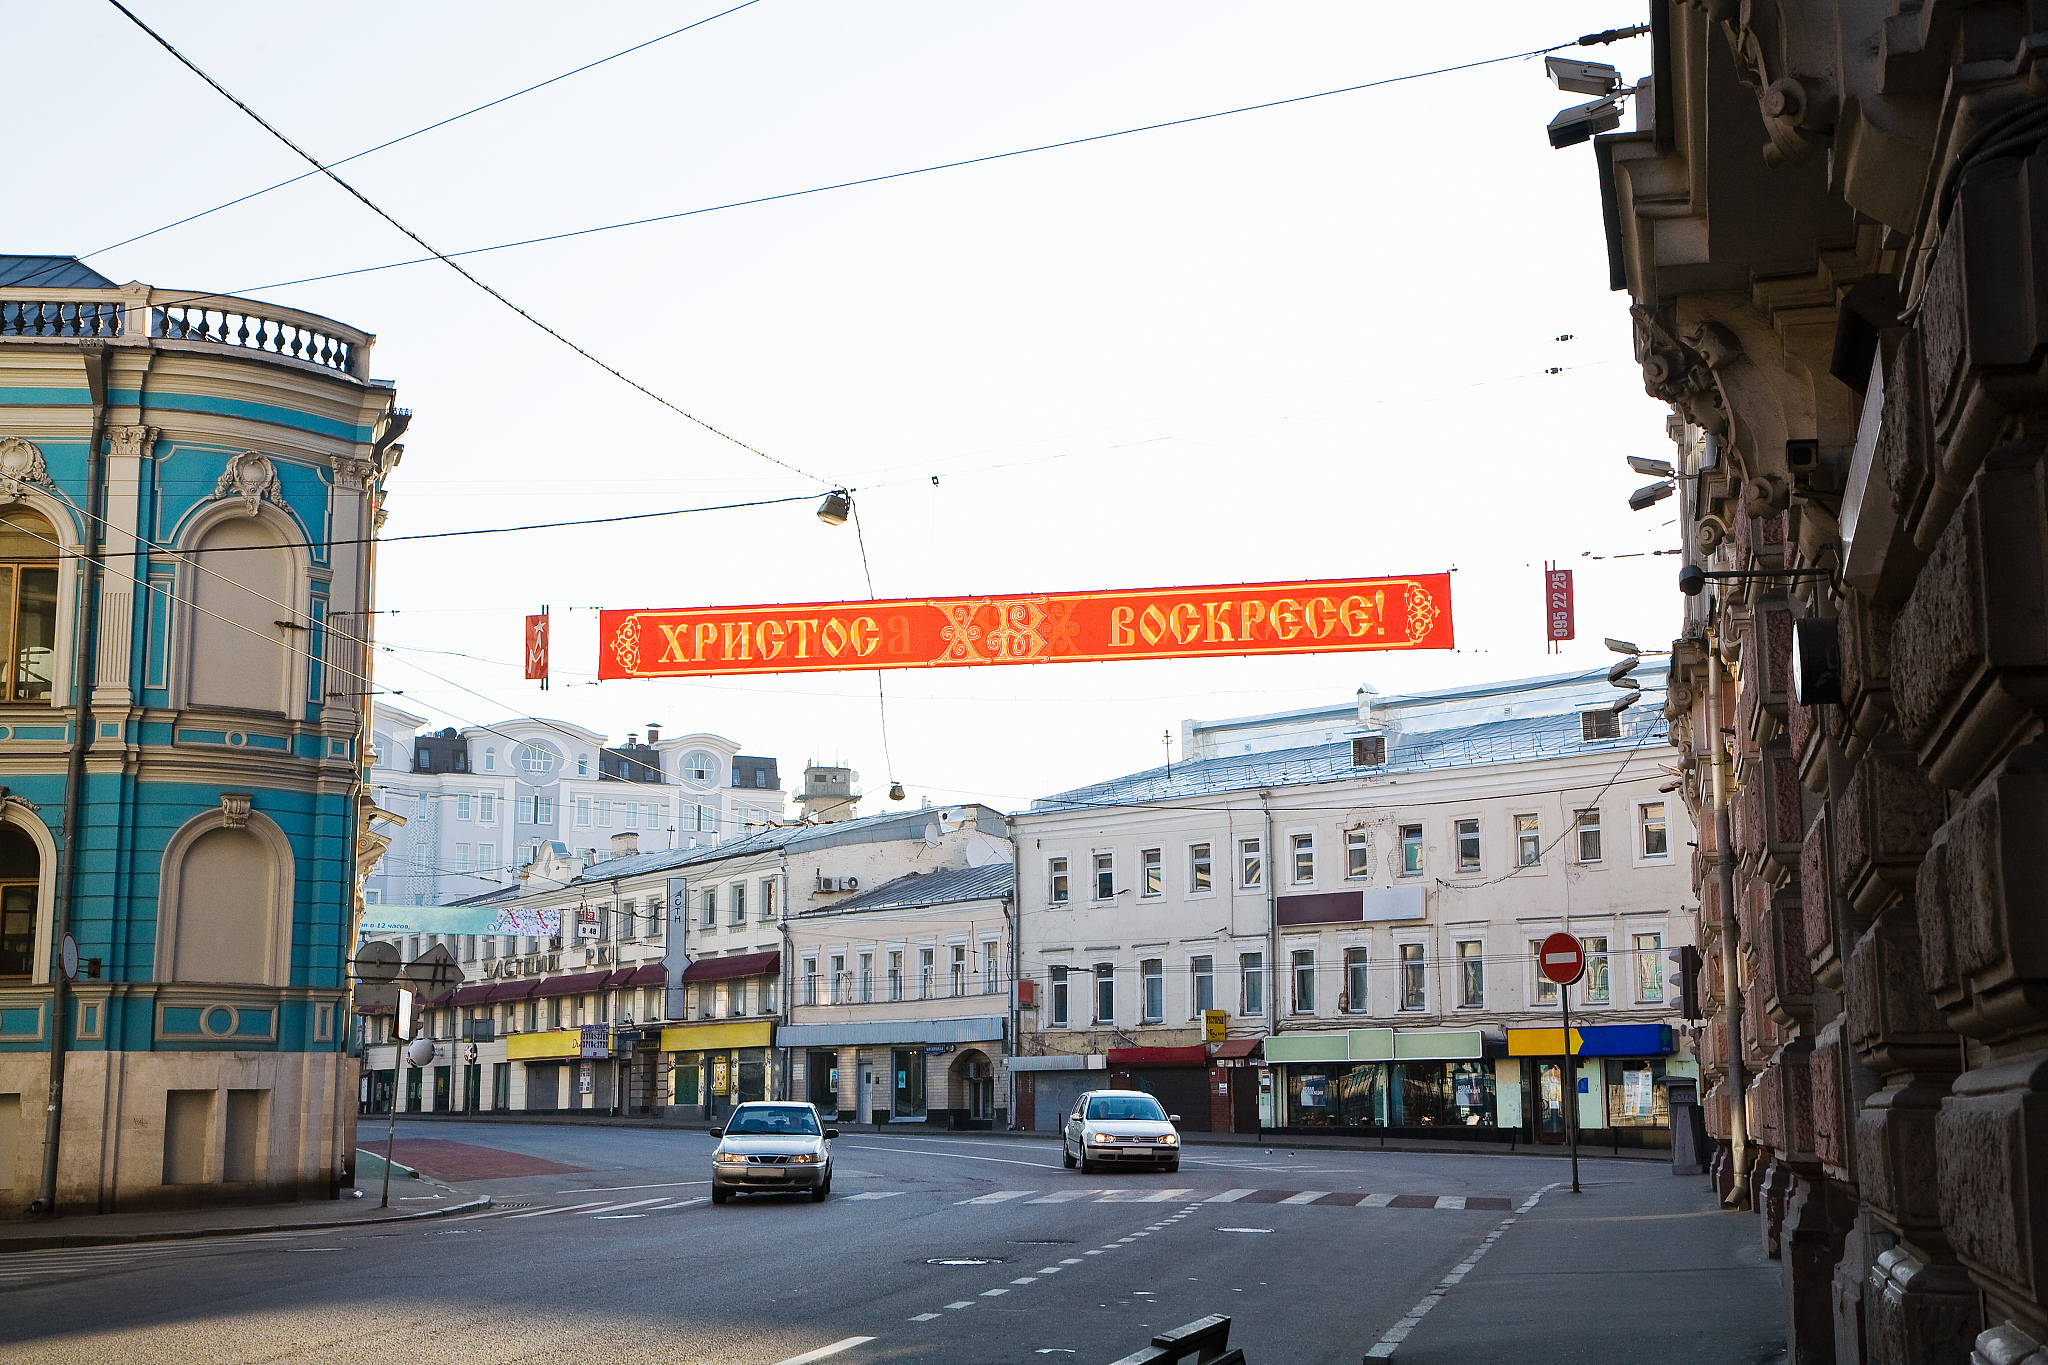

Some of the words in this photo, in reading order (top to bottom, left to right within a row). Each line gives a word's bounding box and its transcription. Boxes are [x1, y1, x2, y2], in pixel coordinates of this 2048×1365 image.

[1552, 572, 1567, 590] 25
[1552, 592, 1567, 608] 22
[1553, 611, 1568, 637] 995
[658, 616, 880, 663] ХРИСТОС
[582, 926, 587, 934] 9
[589, 927, 597, 935] 48
